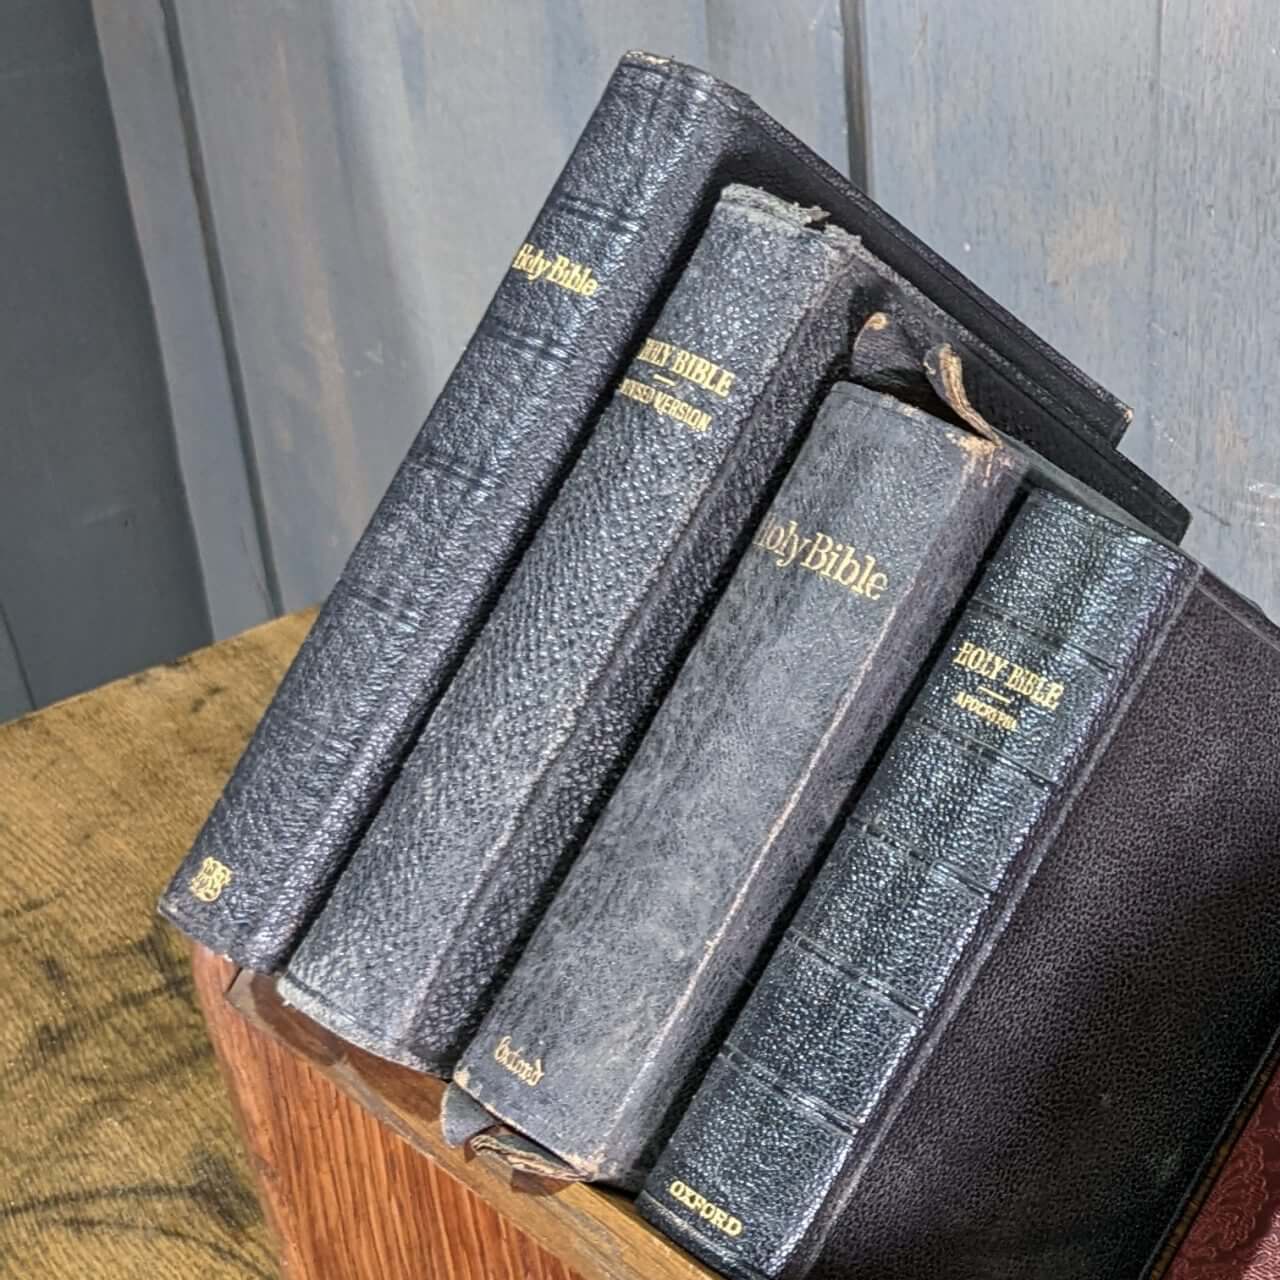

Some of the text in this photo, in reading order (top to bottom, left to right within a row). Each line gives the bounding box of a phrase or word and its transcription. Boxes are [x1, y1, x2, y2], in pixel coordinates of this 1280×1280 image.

[545, 252, 599, 296] Bible
[669, 349, 736, 397] BIBLE
[654, 391, 713, 432] VERSION
[800, 532, 888, 600] Bible
[953, 641, 1064, 710] HOLY BIBLE
[669, 1180, 743, 1237] OXFORD
